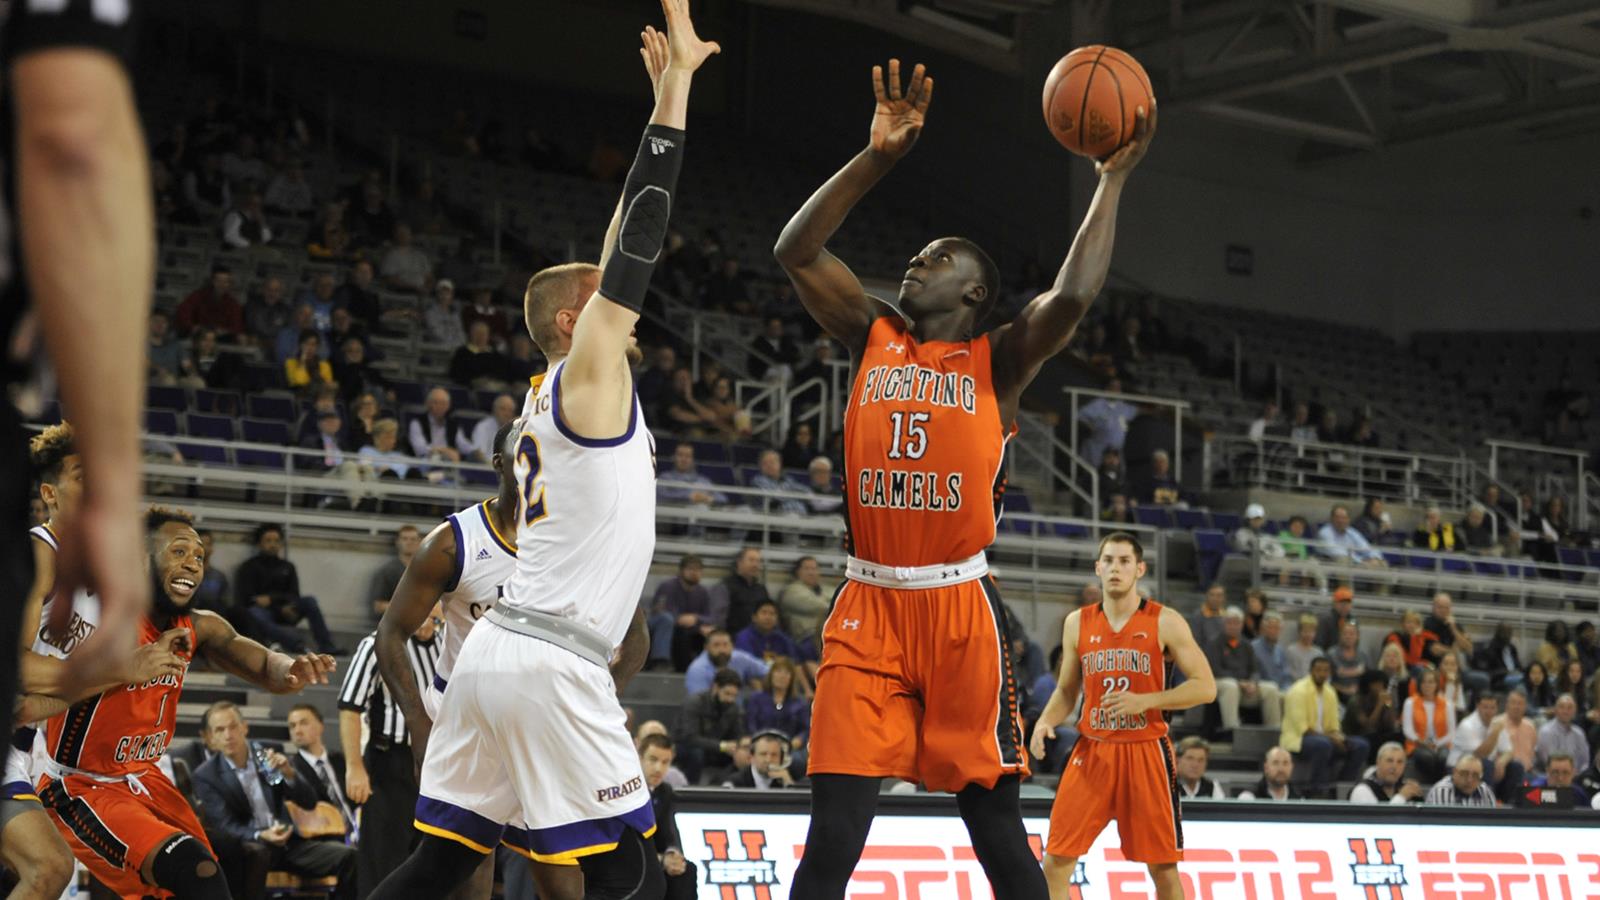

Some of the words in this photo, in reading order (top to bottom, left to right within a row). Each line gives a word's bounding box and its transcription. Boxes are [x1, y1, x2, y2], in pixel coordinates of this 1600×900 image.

[860, 363, 976, 415] FIGHTING
[887, 410, 930, 461] 15
[514, 432, 549, 529] 2
[859, 468, 962, 512] CAMELS
[1081, 648, 1150, 676] FIGHTING
[154, 693, 168, 727] 1
[1090, 707, 1147, 731] CAMELS
[114, 730, 168, 763] CAMEL
